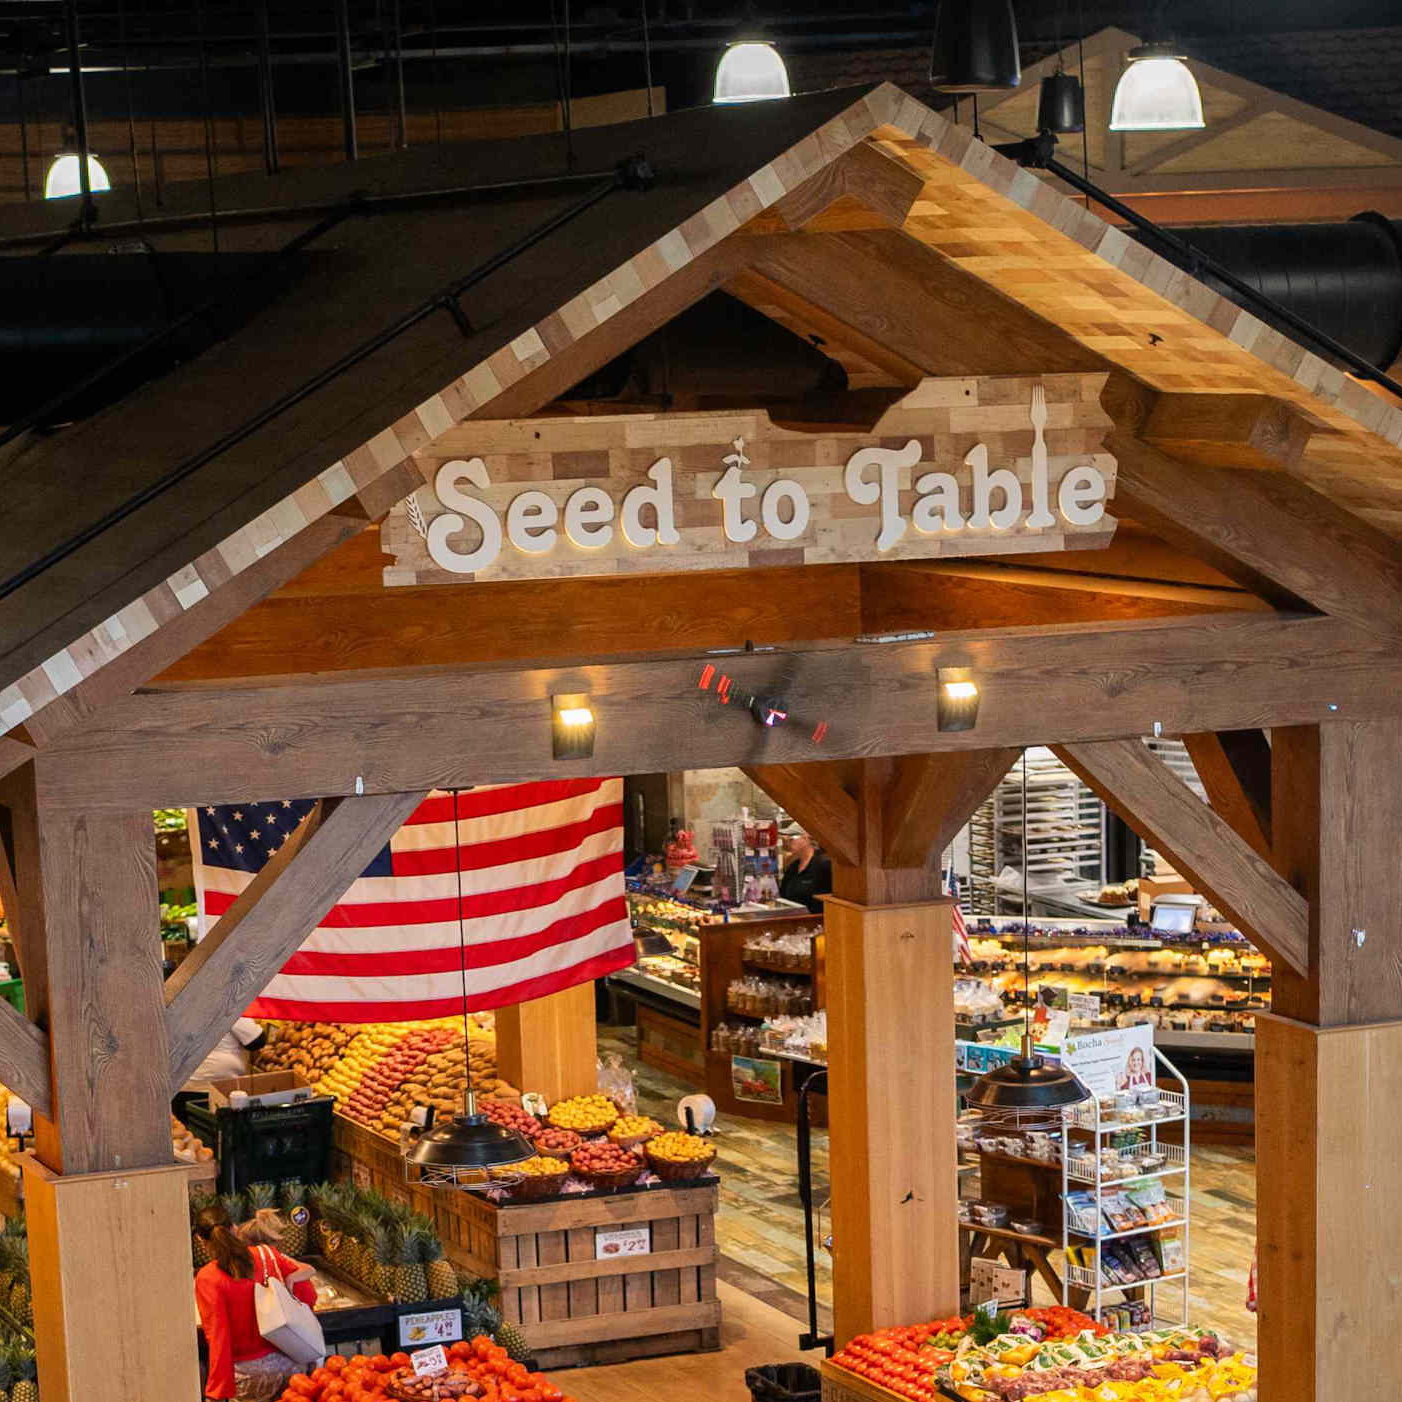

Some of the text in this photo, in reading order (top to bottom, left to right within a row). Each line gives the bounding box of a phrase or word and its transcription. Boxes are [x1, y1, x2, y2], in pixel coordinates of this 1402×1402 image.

[426, 384, 1108, 573] Seed to Table
